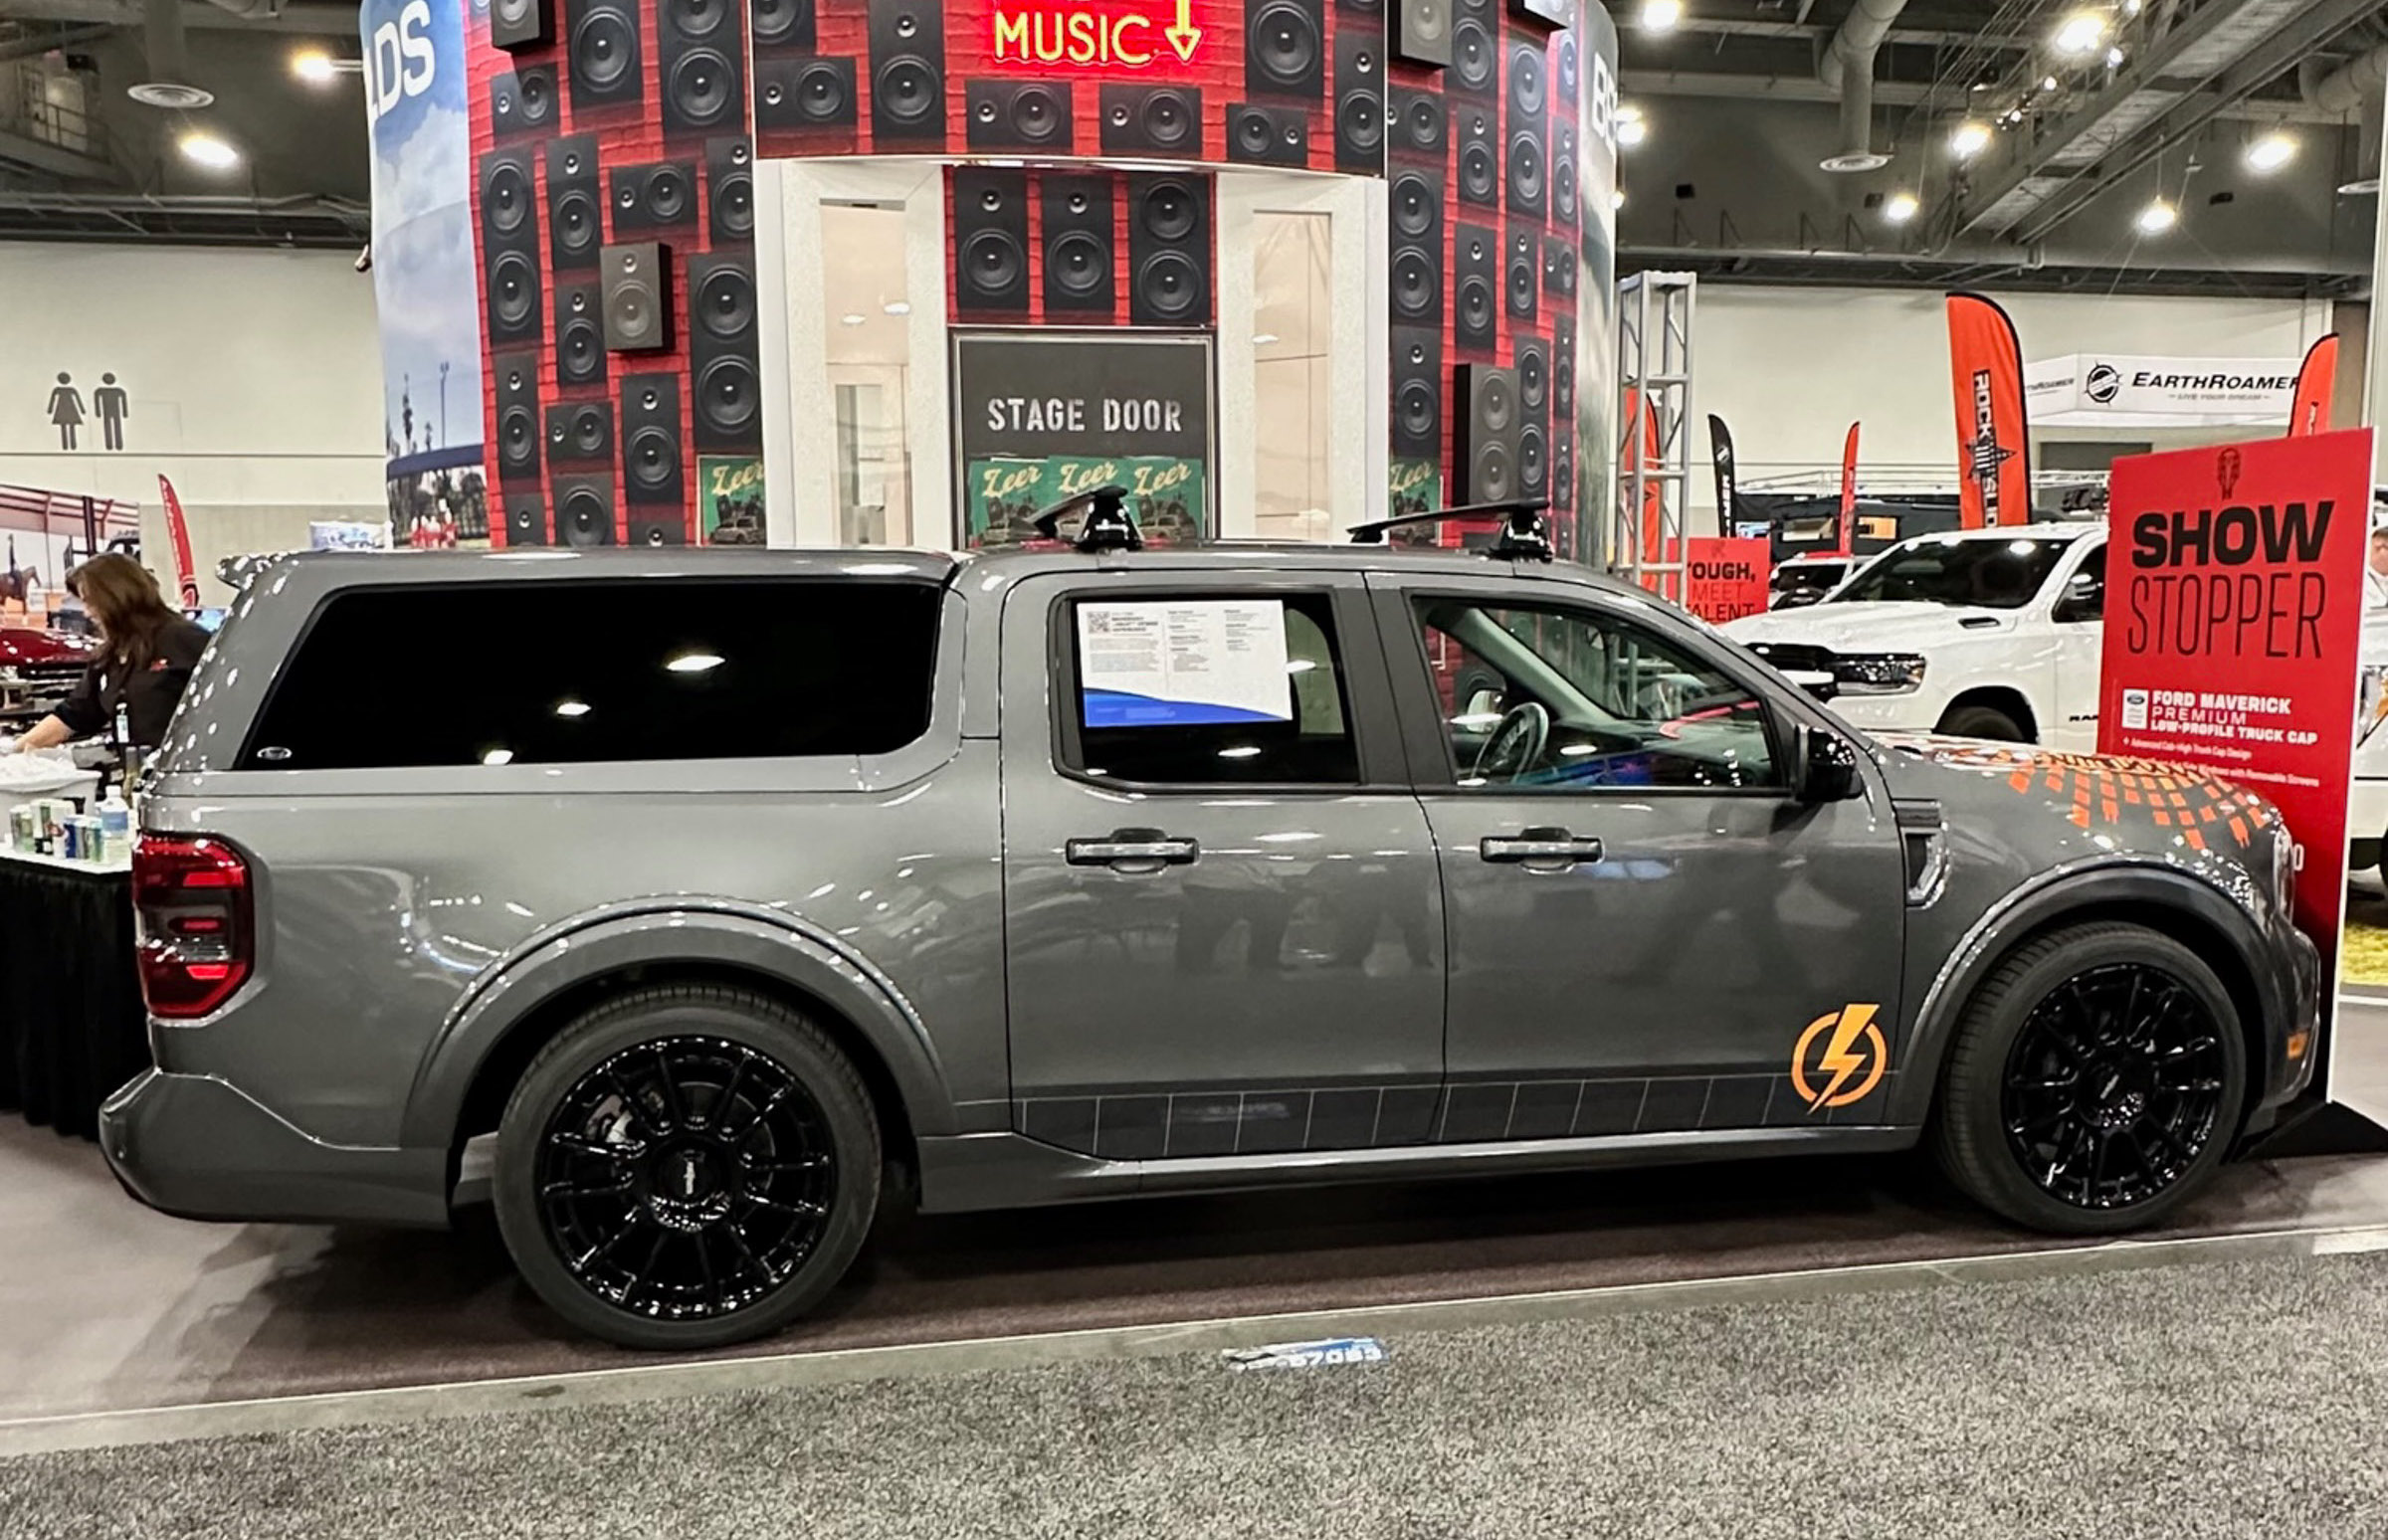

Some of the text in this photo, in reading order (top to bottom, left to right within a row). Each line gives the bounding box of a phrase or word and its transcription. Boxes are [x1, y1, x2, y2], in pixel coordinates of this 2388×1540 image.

[995, 10, 1151, 64] MUSIC
[987, 398, 1182, 432] STAGE DOOR
[1974, 372, 1993, 440] ROCK
[2131, 500, 2336, 569] SHOW
[1688, 562, 1756, 583] OUGH,
[1692, 582, 1744, 602] MEET
[2127, 572, 2326, 660] STOPPER
[2151, 689, 2196, 707] FORD
[2199, 693, 2291, 714] MAVERICK
[2151, 706, 2248, 725] PREMIUM
[2150, 719, 2318, 745] LOW-PROFILE TRUCK CAP
